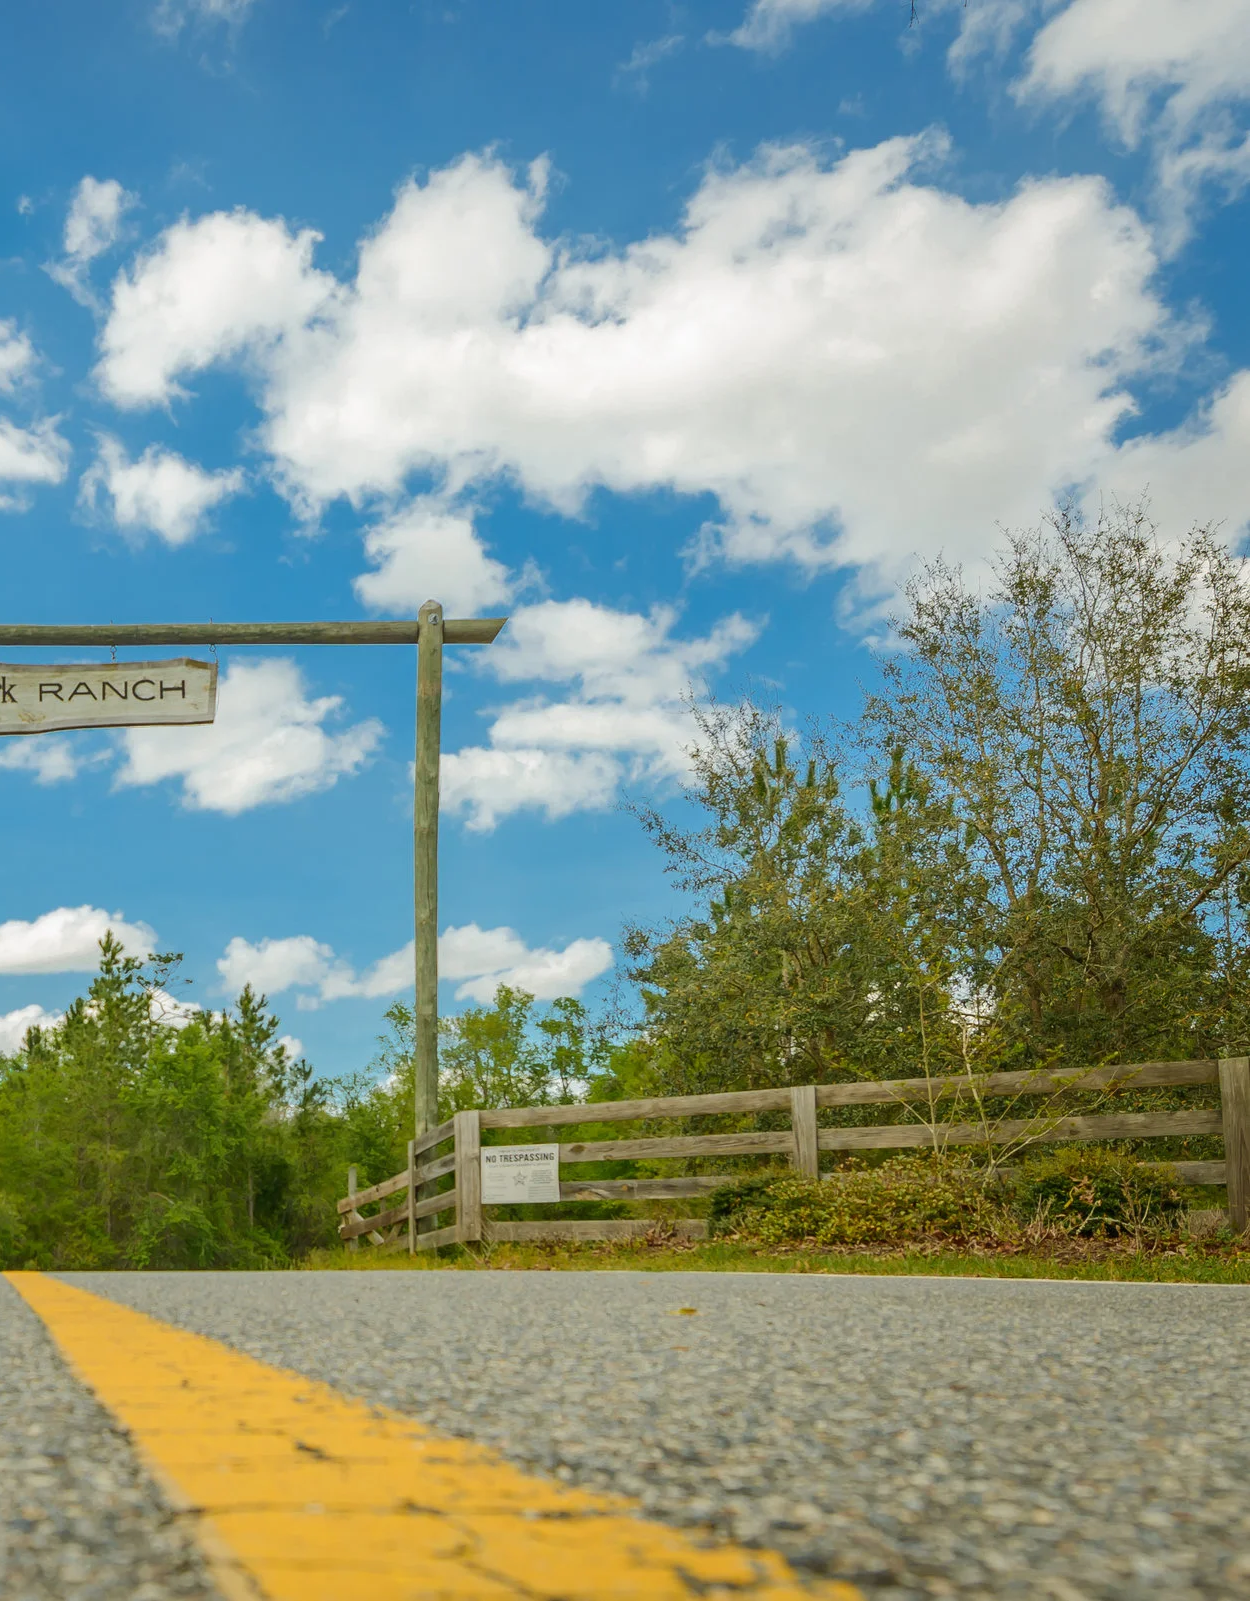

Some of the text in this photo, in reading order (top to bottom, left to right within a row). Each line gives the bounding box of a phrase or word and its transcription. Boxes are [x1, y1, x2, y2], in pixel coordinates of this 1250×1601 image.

[39, 679, 187, 702] RANCH
[485, 1152, 555, 1163] NO TRESPASSING
